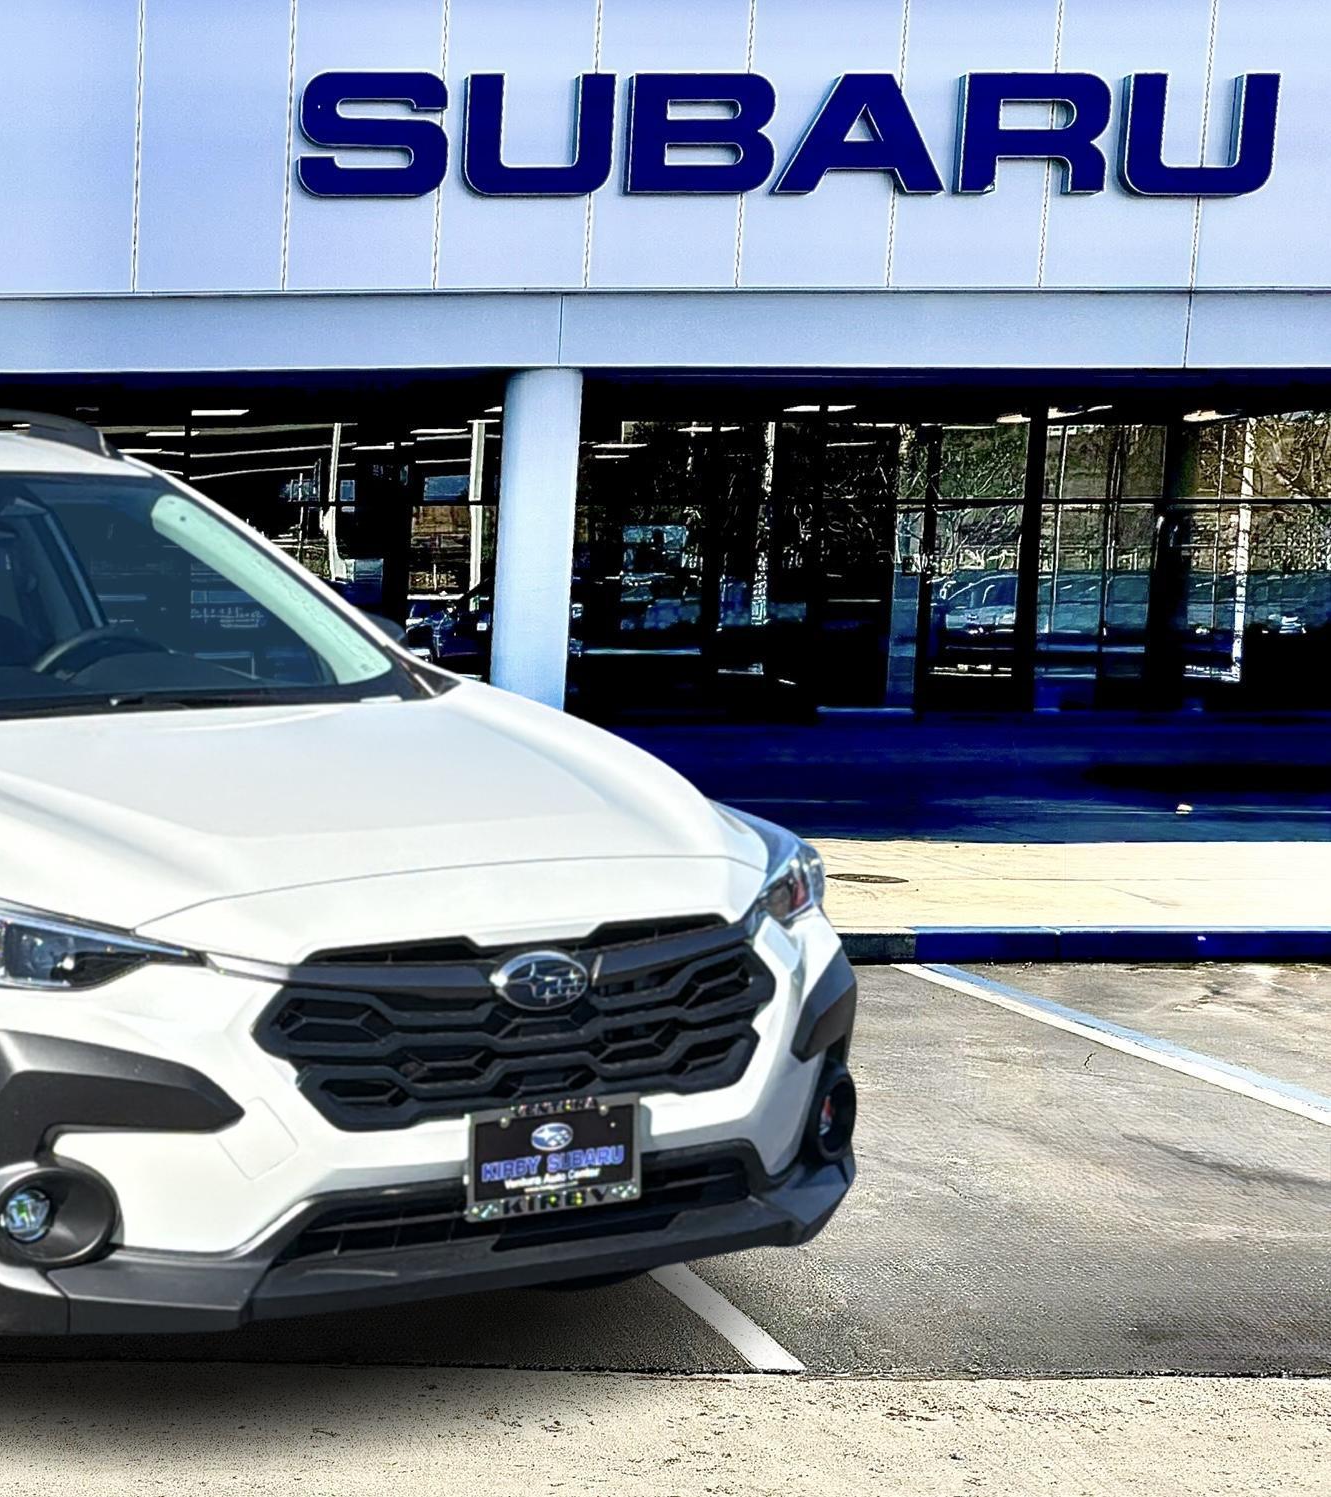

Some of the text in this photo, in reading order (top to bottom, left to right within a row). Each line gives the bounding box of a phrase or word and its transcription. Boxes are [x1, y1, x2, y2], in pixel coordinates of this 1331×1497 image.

[296, 70, 1282, 198] SUBARU
[481, 1144, 625, 1183] KIRBY SUBARU
[504, 1175, 542, 1190] Ventura
[543, 1172, 567, 1184] Auto
[568, 1167, 601, 1180] Center
[501, 1186, 610, 1214] KIRBY
